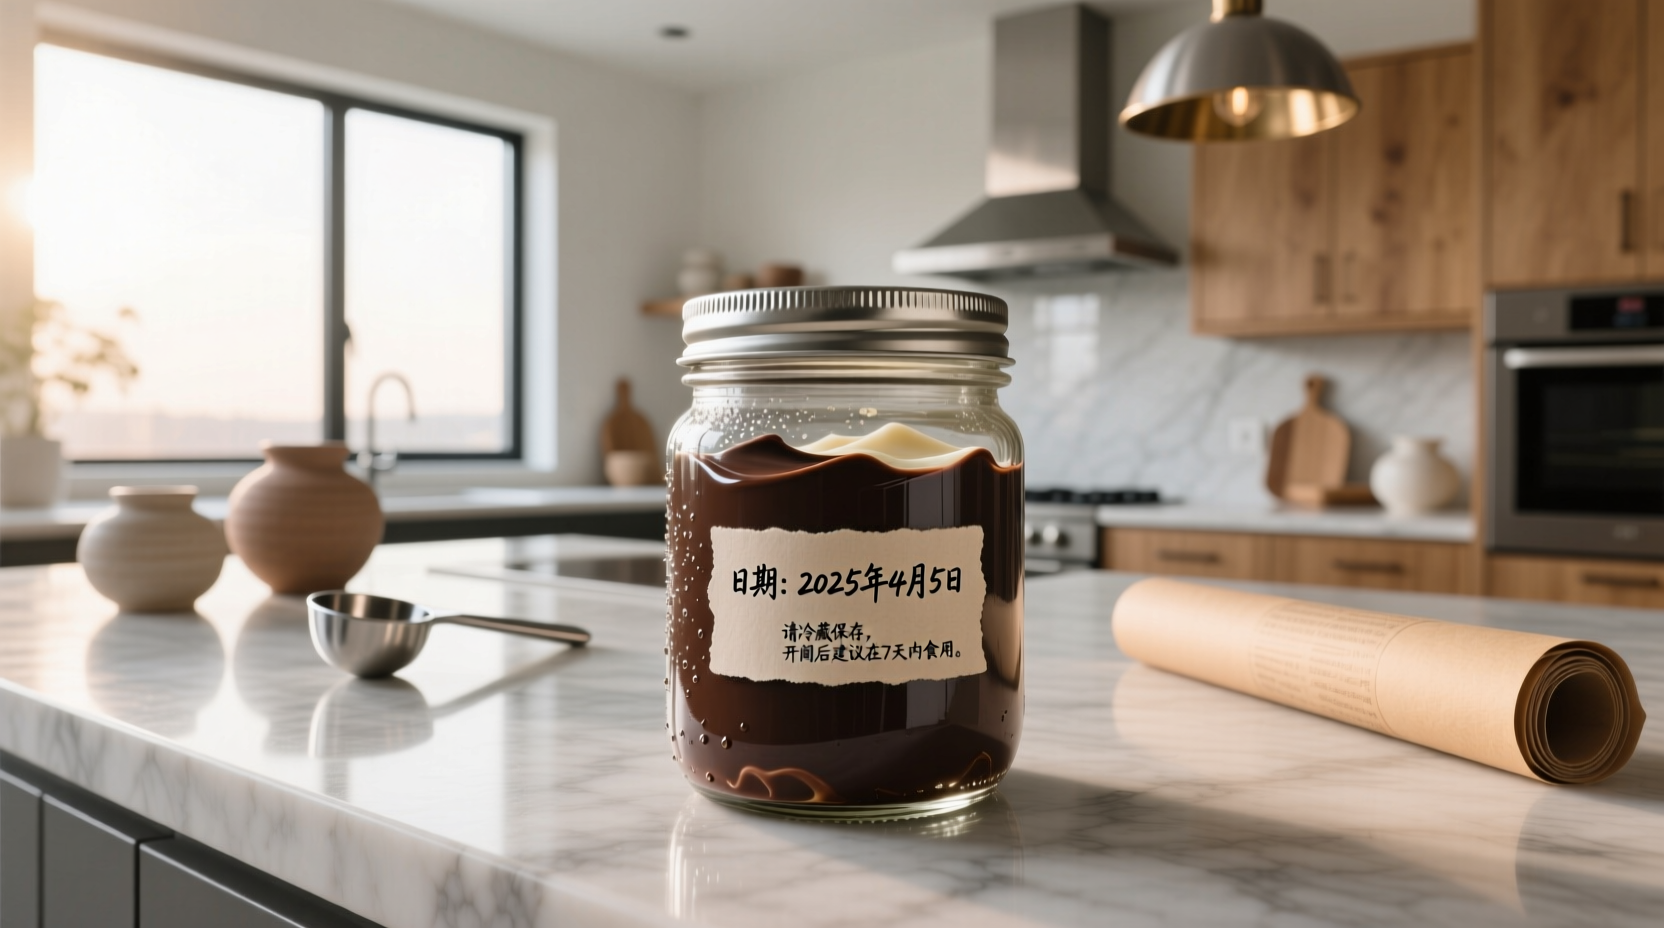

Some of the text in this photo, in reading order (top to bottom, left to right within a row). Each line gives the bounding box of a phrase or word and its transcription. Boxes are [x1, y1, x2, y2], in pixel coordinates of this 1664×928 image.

[797, 562, 962, 604] 2025年4月5日
[781, 620, 873, 643] 请冷藏保存，
